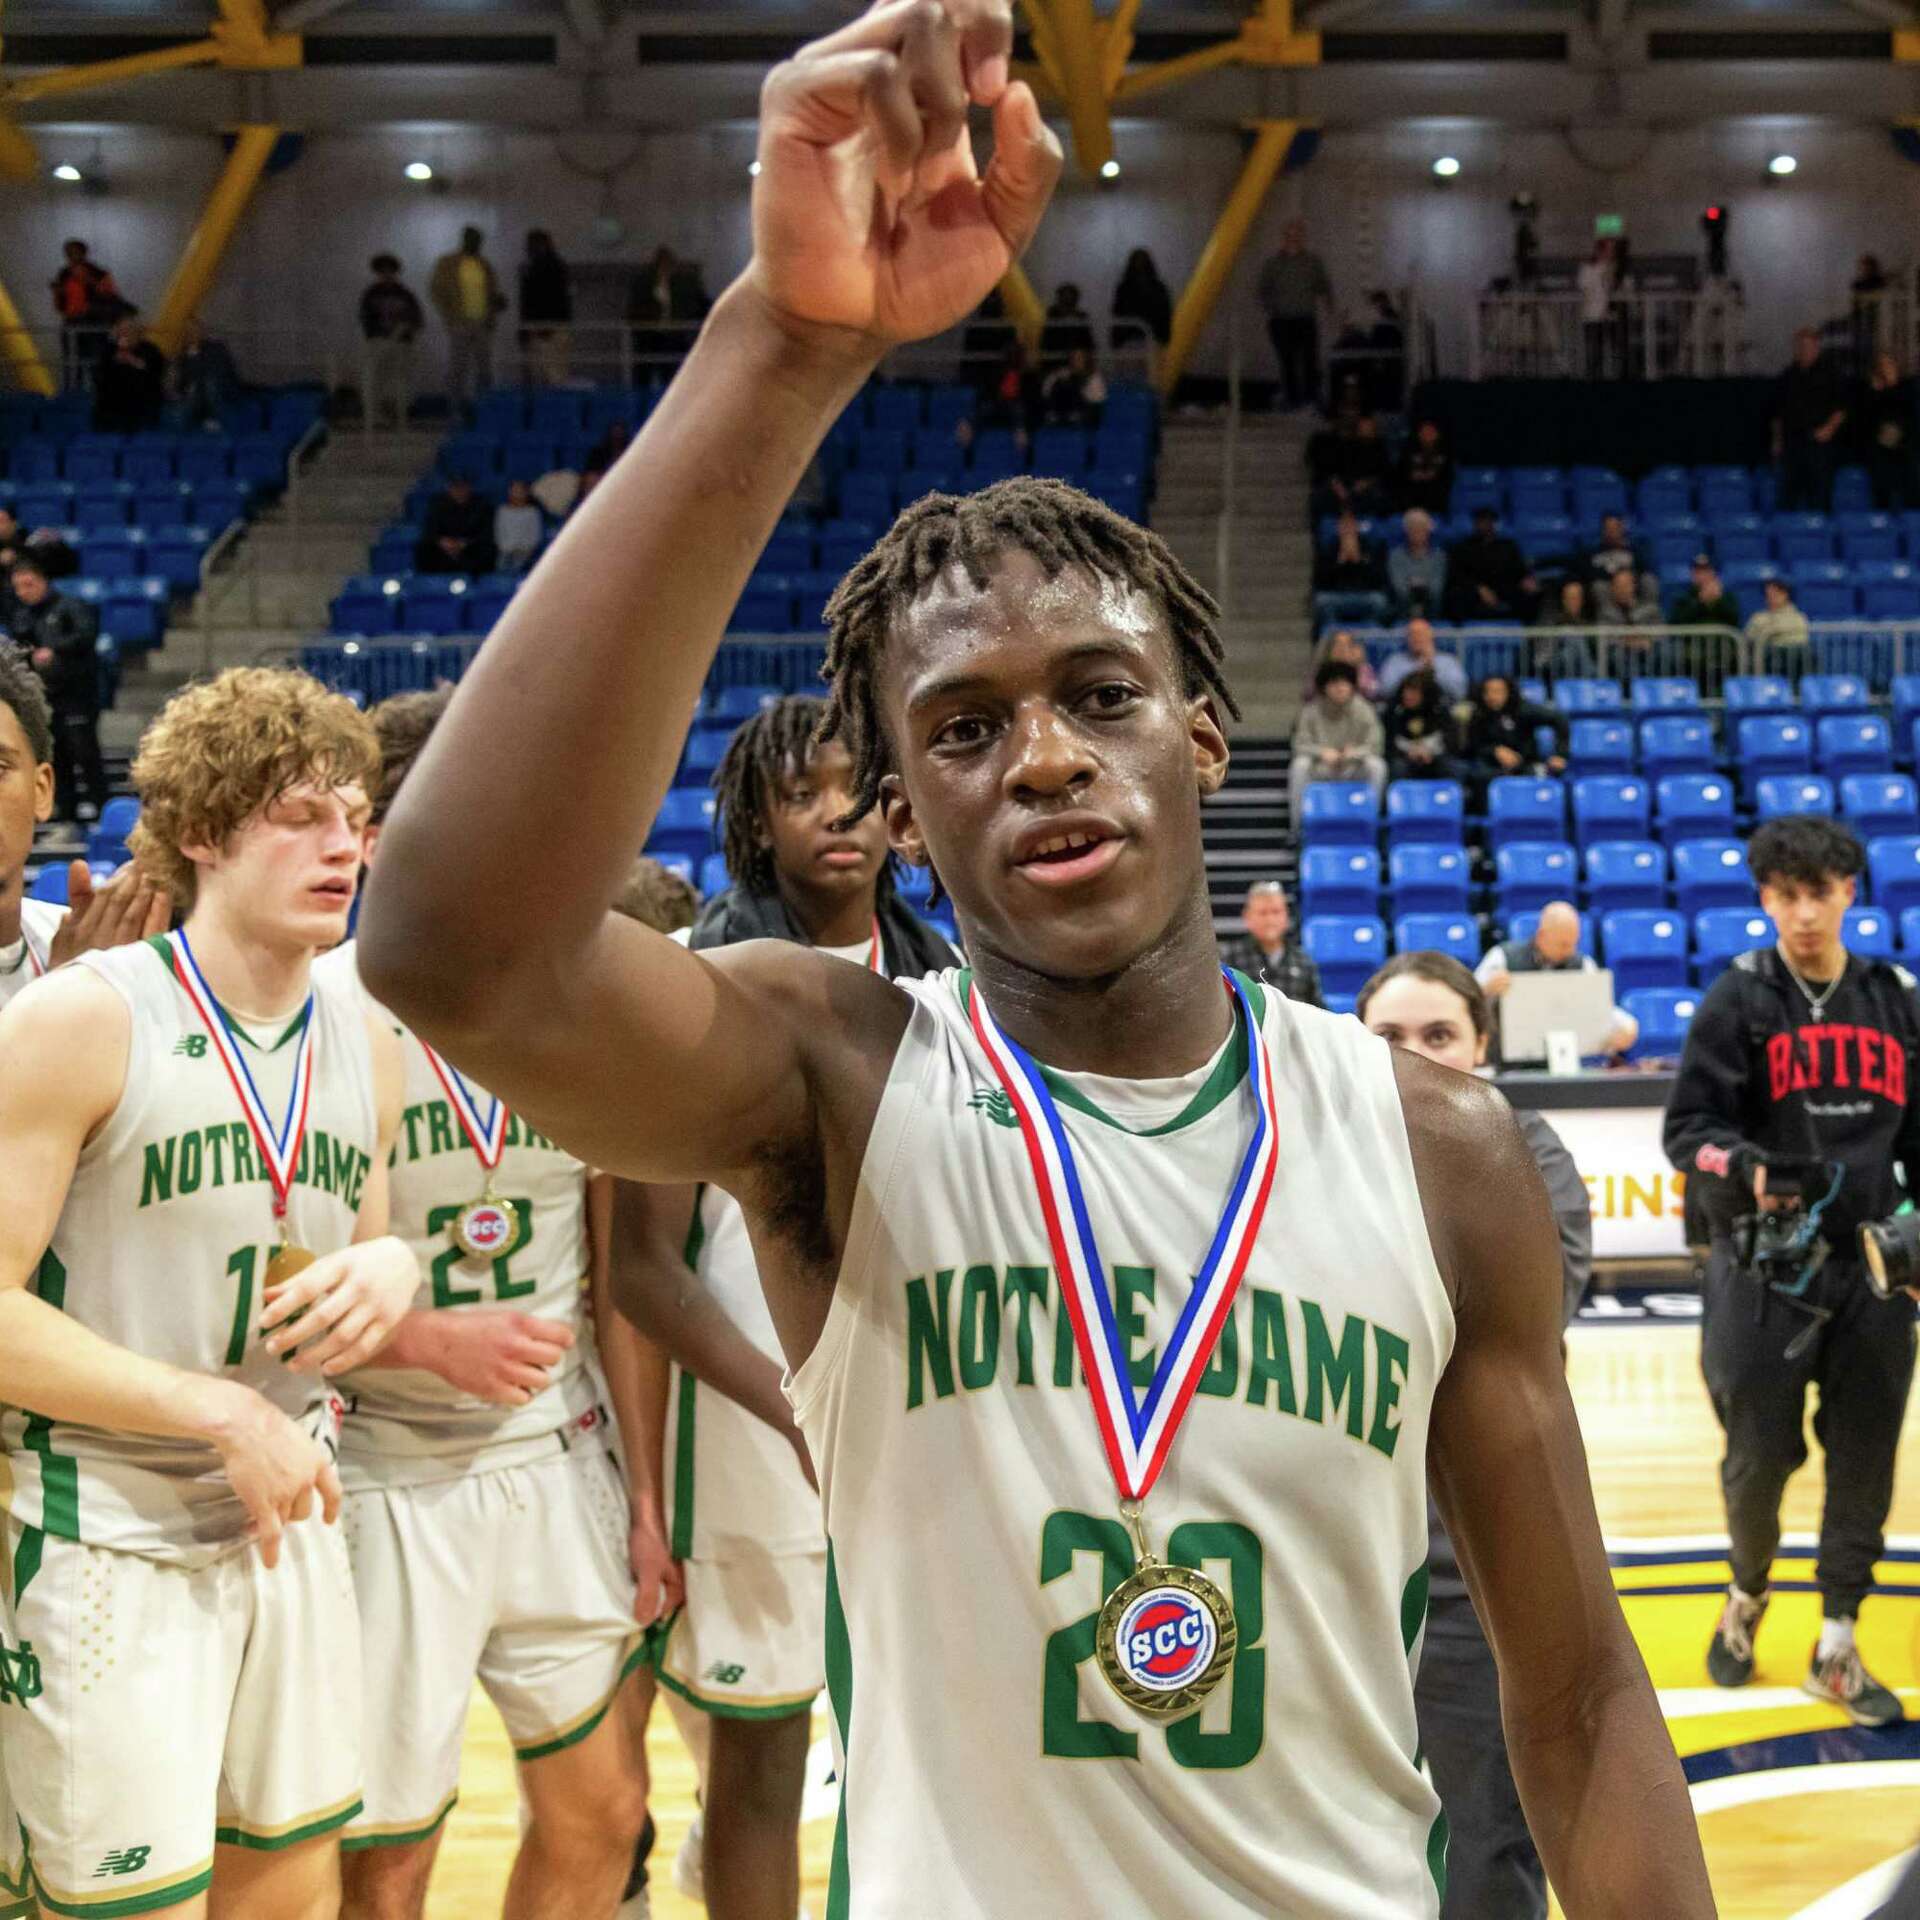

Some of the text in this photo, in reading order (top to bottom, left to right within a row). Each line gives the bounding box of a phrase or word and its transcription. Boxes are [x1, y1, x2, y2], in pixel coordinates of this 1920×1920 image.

[224, 1246, 310, 1365] 1
[427, 1198, 536, 1308] 22
[1039, 1507, 1267, 1769] 23
[1130, 1612, 1202, 1666] SCC
